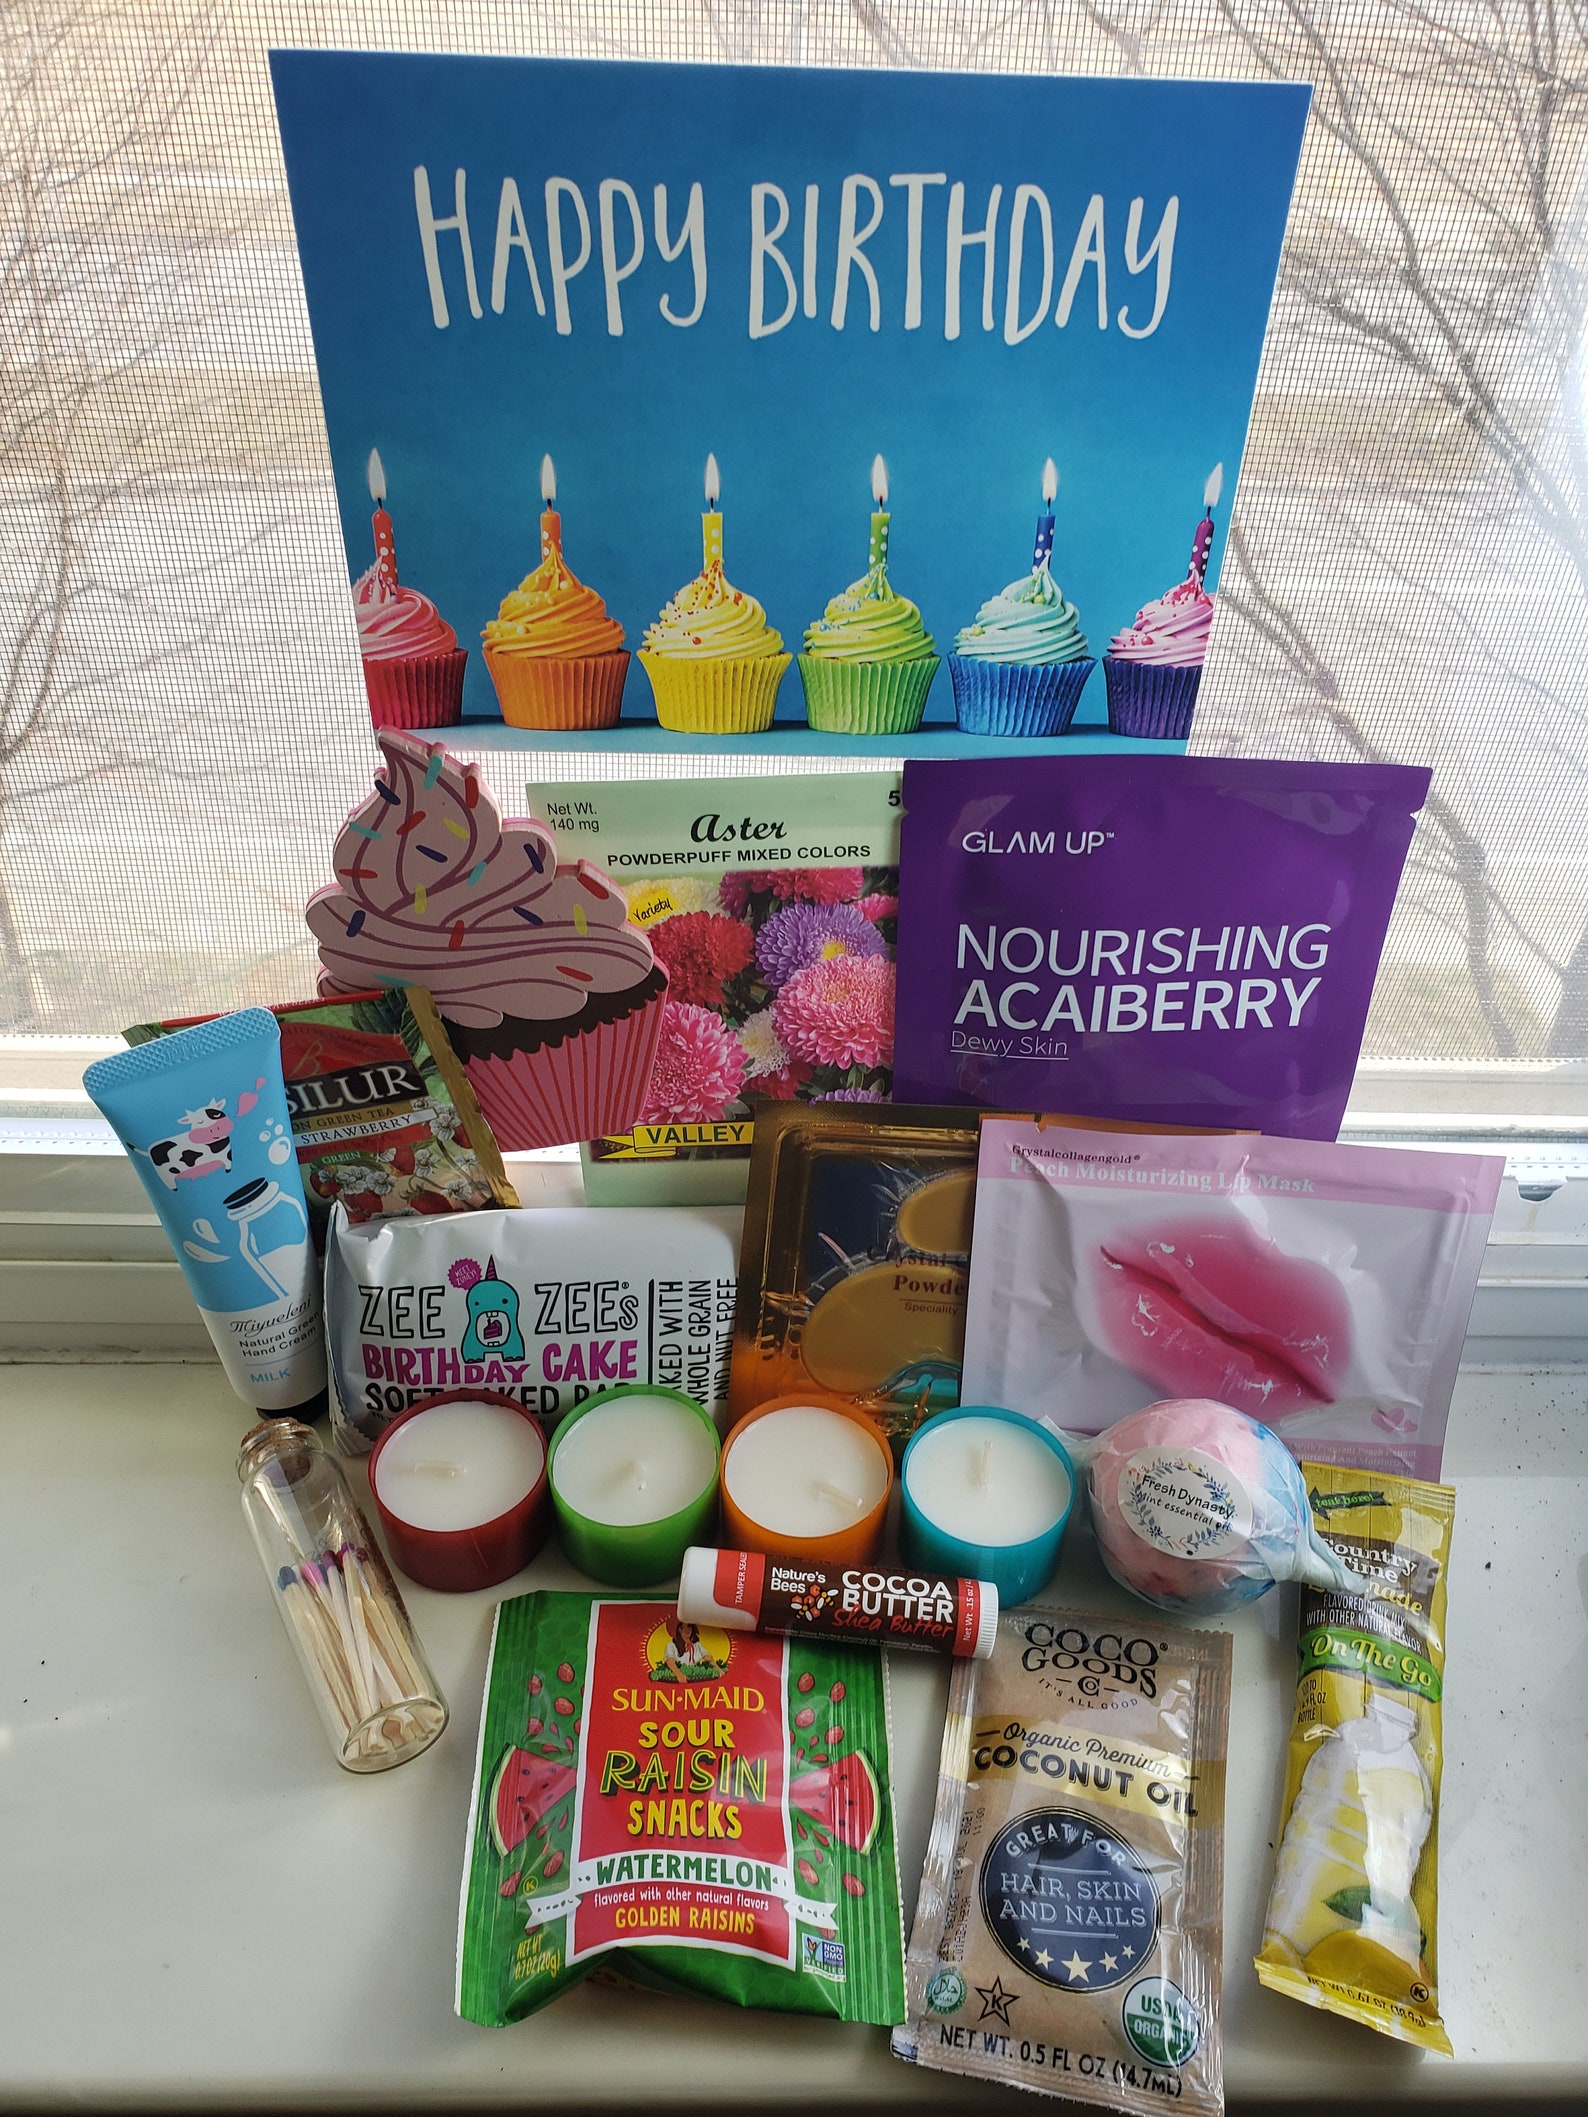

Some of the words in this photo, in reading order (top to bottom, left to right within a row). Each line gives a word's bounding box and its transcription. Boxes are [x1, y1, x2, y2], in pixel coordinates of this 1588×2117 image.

[414, 165, 707, 337] HAPPY
[747, 172, 1181, 346] BIRTHDAY
[547, 803, 571, 815] Net
[574, 802, 597, 814] Wt.
[551, 818, 574, 831] 140
[579, 820, 600, 832] mg
[690, 814, 788, 843] Aster
[607, 849, 732, 866] POWDERPUFF
[737, 845, 792, 862] MIXED
[797, 844, 871, 859] COLORS
[962, 831, 1055, 854] GLAM
[633, 897, 674, 922] Variety
[956, 923, 1333, 977] NOURISHING
[952, 977, 1323, 1034] ACAIBERRY
[950, 1030, 1013, 1057] Dewy
[1019, 1035, 1068, 1056] Skin
[285, 1065, 420, 1114] SILUR
[291, 1120, 312, 1132] ON
[316, 1110, 363, 1127] GREEN
[367, 1107, 395, 1119] TEA
[300, 1114, 413, 1145] STRAWBERRY
[645, 1124, 746, 1145] VALLEY
[321, 1150, 361, 1165] GREEN
[1009, 1156, 1069, 1178] Peach
[1075, 1162, 1213, 1193] Moisturizing
[1218, 1172, 1252, 1194] Lip
[1256, 1174, 1316, 1194] Mask
[717, 1277, 739, 1323] FREE
[891, 1275, 966, 1295] Powde
[358, 1284, 446, 1340] ZEE
[658, 1281, 683, 1337] WITH
[687, 1280, 712, 1338] GRAIN
[904, 1301, 959, 1316] Speciality
[239, 1331, 286, 1348] Natural
[288, 1310, 320, 1336] Green
[242, 1346, 276, 1357] Hand
[279, 1325, 316, 1350] Cream
[715, 1330, 735, 1363] NUT
[250, 1367, 292, 1383] MILK
[361, 1342, 531, 1386] BIRTHDAY
[542, 1339, 639, 1383] CAKE
[658, 1343, 683, 1390] KED
[687, 1343, 711, 1406] WHOLE
[713, 1368, 731, 1400] AND
[459, 1386, 559, 1415] KED
[1138, 1491, 1161, 1506] Mint
[1164, 1502, 1213, 1526] essential
[1142, 1474, 1176, 1497] Fresh
[1178, 1488, 1234, 1519] Dynasty
[1323, 1538, 1418, 1577] Country
[1340, 1556, 1398, 1583] Time
[734, 1572, 746, 1605] TAMPER
[770, 1578, 807, 1594] Bees
[771, 1566, 827, 1584] Nature's
[841, 1570, 951, 1599] COCOA
[842, 1588, 954, 1623] BUTTER
[1306, 1609, 1326, 1626] WITH
[1329, 1608, 1355, 1626] OTHER
[1323, 1594, 1364, 1611] FLAVORED
[832, 1603, 881, 1632] Shea
[891, 1612, 955, 1639] Butter
[963, 1627, 972, 1642] Net
[1021, 1647, 1157, 1699] GOODS
[1311, 1633, 1348, 1657] On
[1351, 1638, 1397, 1670] The
[1401, 1656, 1433, 1688] Go
[1038, 1677, 1063, 1697] IT'S
[1068, 1696, 1094, 1708] ALL
[1101, 1697, 1138, 1710] GOOD
[1317, 1691, 1327, 1705] OZ
[638, 1720, 736, 1750] SOUR
[1003, 1722, 1082, 1756] Organic
[1086, 1738, 1171, 1779] Premium
[599, 1750, 768, 1804] RAISIN
[974, 1746, 1134, 1796] COCONUT
[1146, 1781, 1200, 1817] OIL
[627, 1799, 743, 1840] SNACKS
[1005, 1822, 1080, 1858] GREAT
[1080, 1829, 1127, 1868] FOR
[595, 1853, 774, 1892] WATERMELON
[1000, 1872, 1072, 1902] HAIR,
[1077, 1879, 1142, 1902] SKIN
[594, 1888, 636, 1908] flavored
[639, 1887, 662, 1903] with
[665, 1887, 693, 1903] other
[696, 1888, 734, 1906] natural
[736, 1892, 769, 1912] flavors
[1000, 1900, 1058, 1922] AND
[1061, 1903, 1148, 1928] NAILS
[615, 1905, 680, 1929] GOLDEN
[689, 1906, 755, 1935] RAISINS
[517, 1938, 532, 1961] NET
[823, 1943, 842, 1954] NON
[823, 1950, 843, 1961] GMO
[1141, 1994, 1182, 2024] USDA
[940, 2024, 977, 2050] NET
[983, 2033, 1013, 2058] WT.
[1020, 2041, 1046, 2066] 0.5
[1052, 2047, 1072, 2071] FL
[1078, 2054, 1106, 2079] OZ
